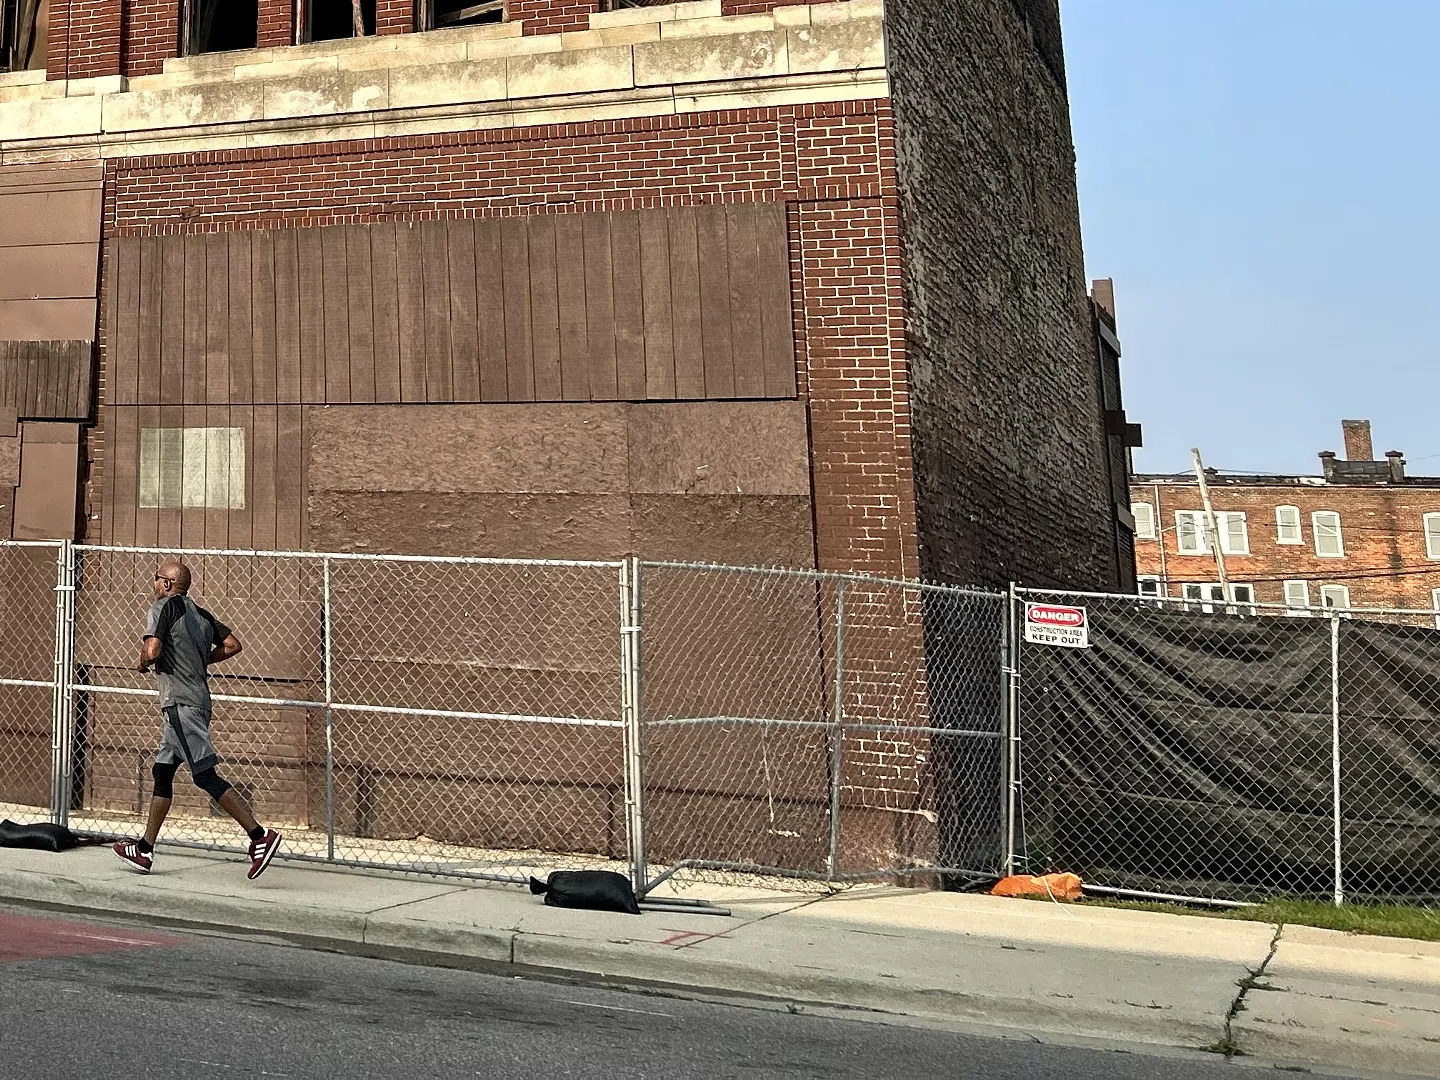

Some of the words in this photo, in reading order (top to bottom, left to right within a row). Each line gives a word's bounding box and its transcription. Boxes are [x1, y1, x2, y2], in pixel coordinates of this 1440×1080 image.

[1032, 609, 1079, 622] DANGER
[1032, 633, 1058, 642] KEEP
[1061, 636, 1081, 644] OUT
